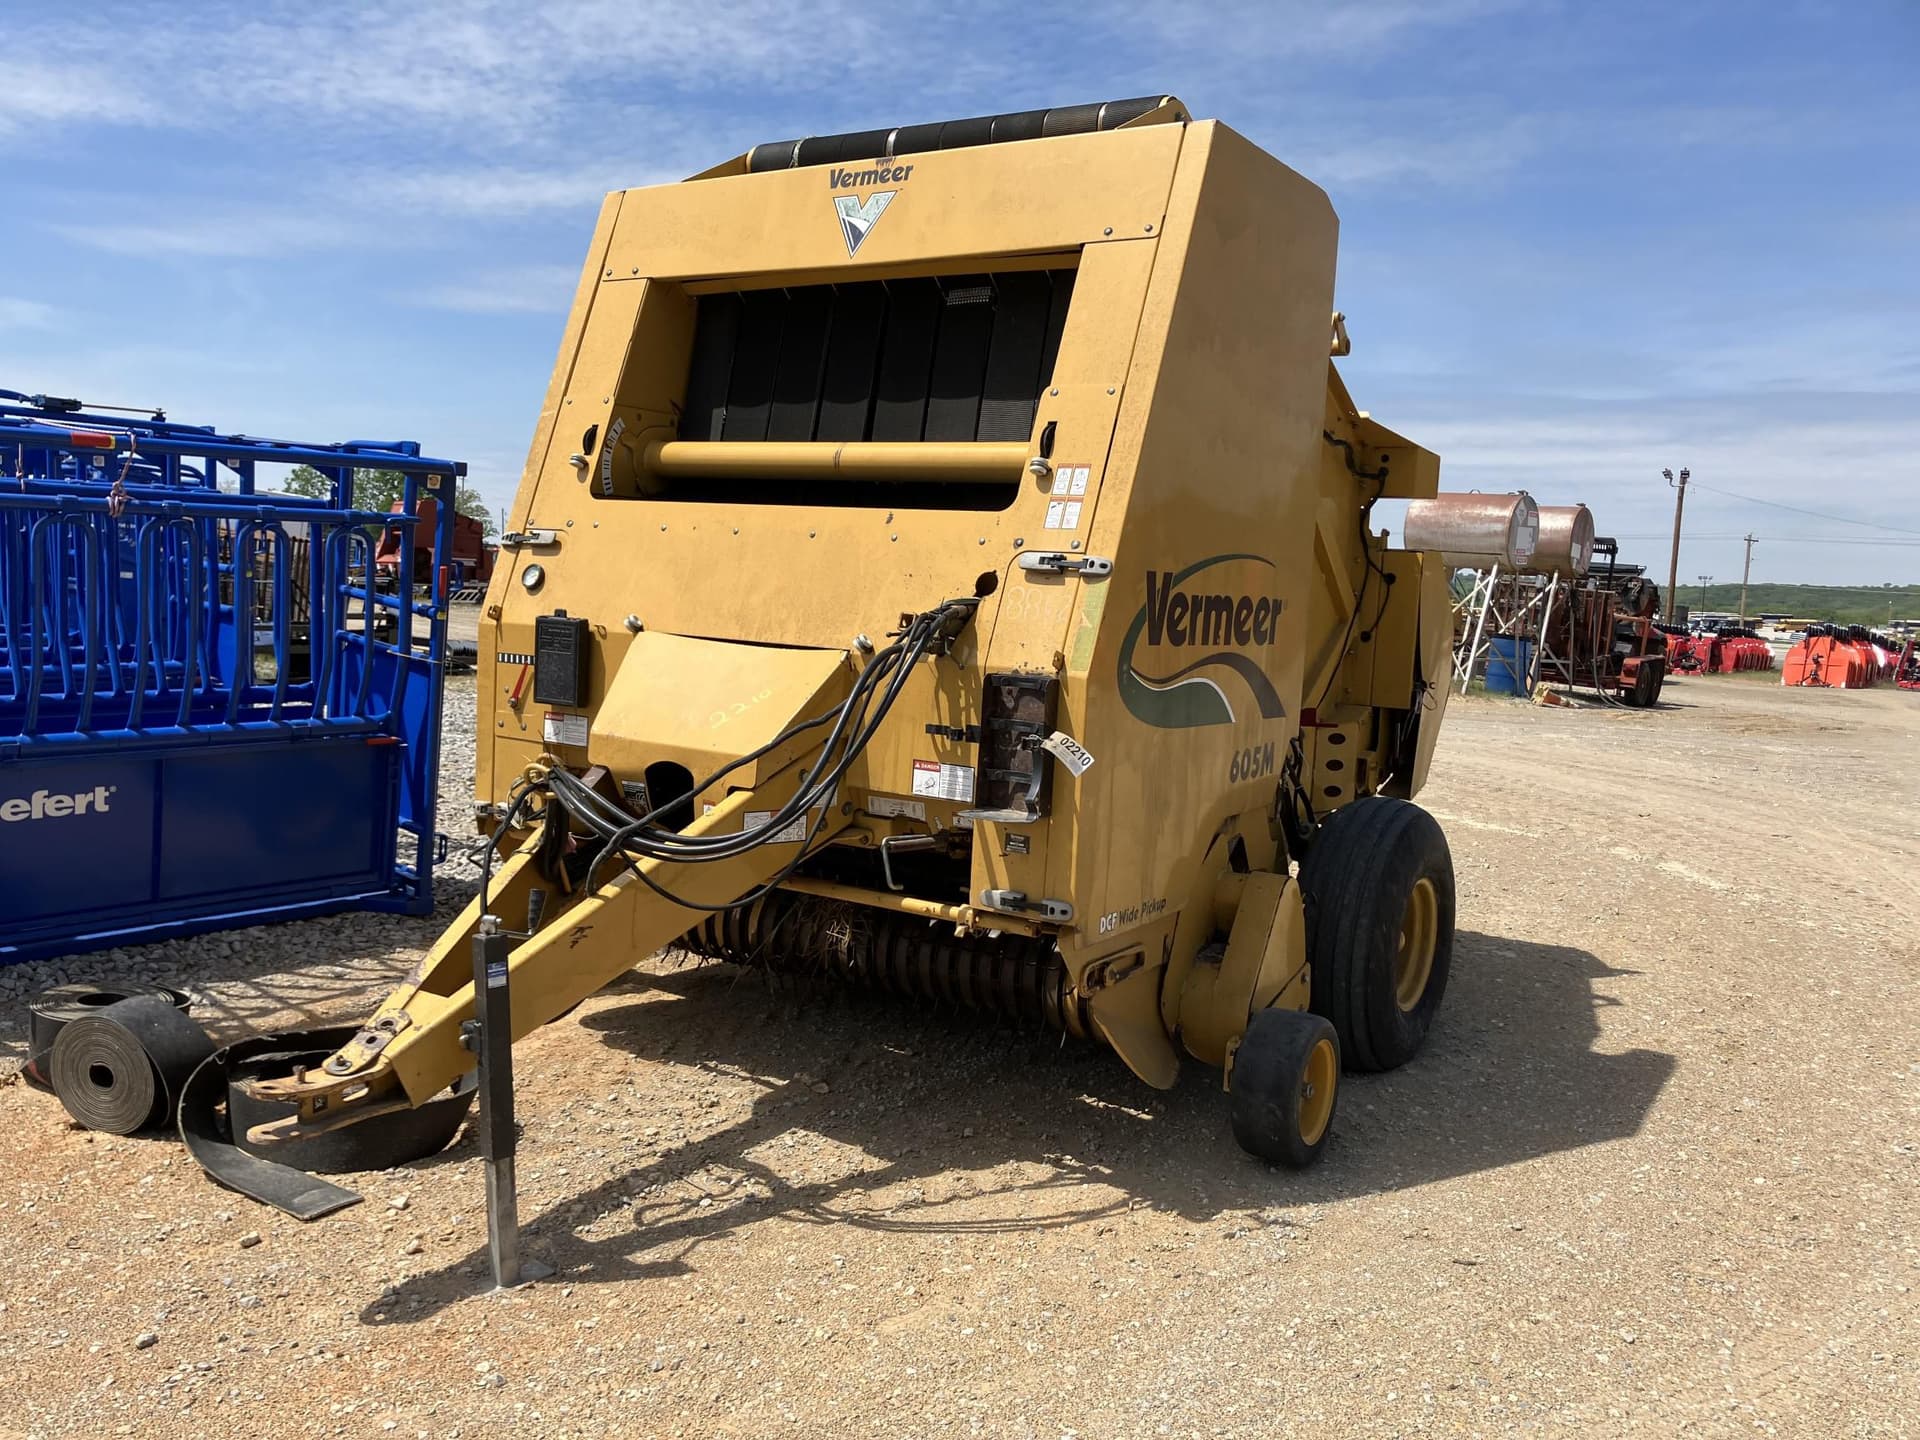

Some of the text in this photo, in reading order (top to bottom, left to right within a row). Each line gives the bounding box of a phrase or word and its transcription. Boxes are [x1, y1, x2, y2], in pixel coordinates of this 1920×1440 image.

[830, 165, 914, 189] Vermeer
[1146, 571, 1283, 647] Vermeer
[1060, 737, 1092, 767] 02210
[1229, 742, 1275, 784] 605M
[0, 786, 110, 822] efert
[1099, 897, 1167, 935] DCF Wide Pickup
